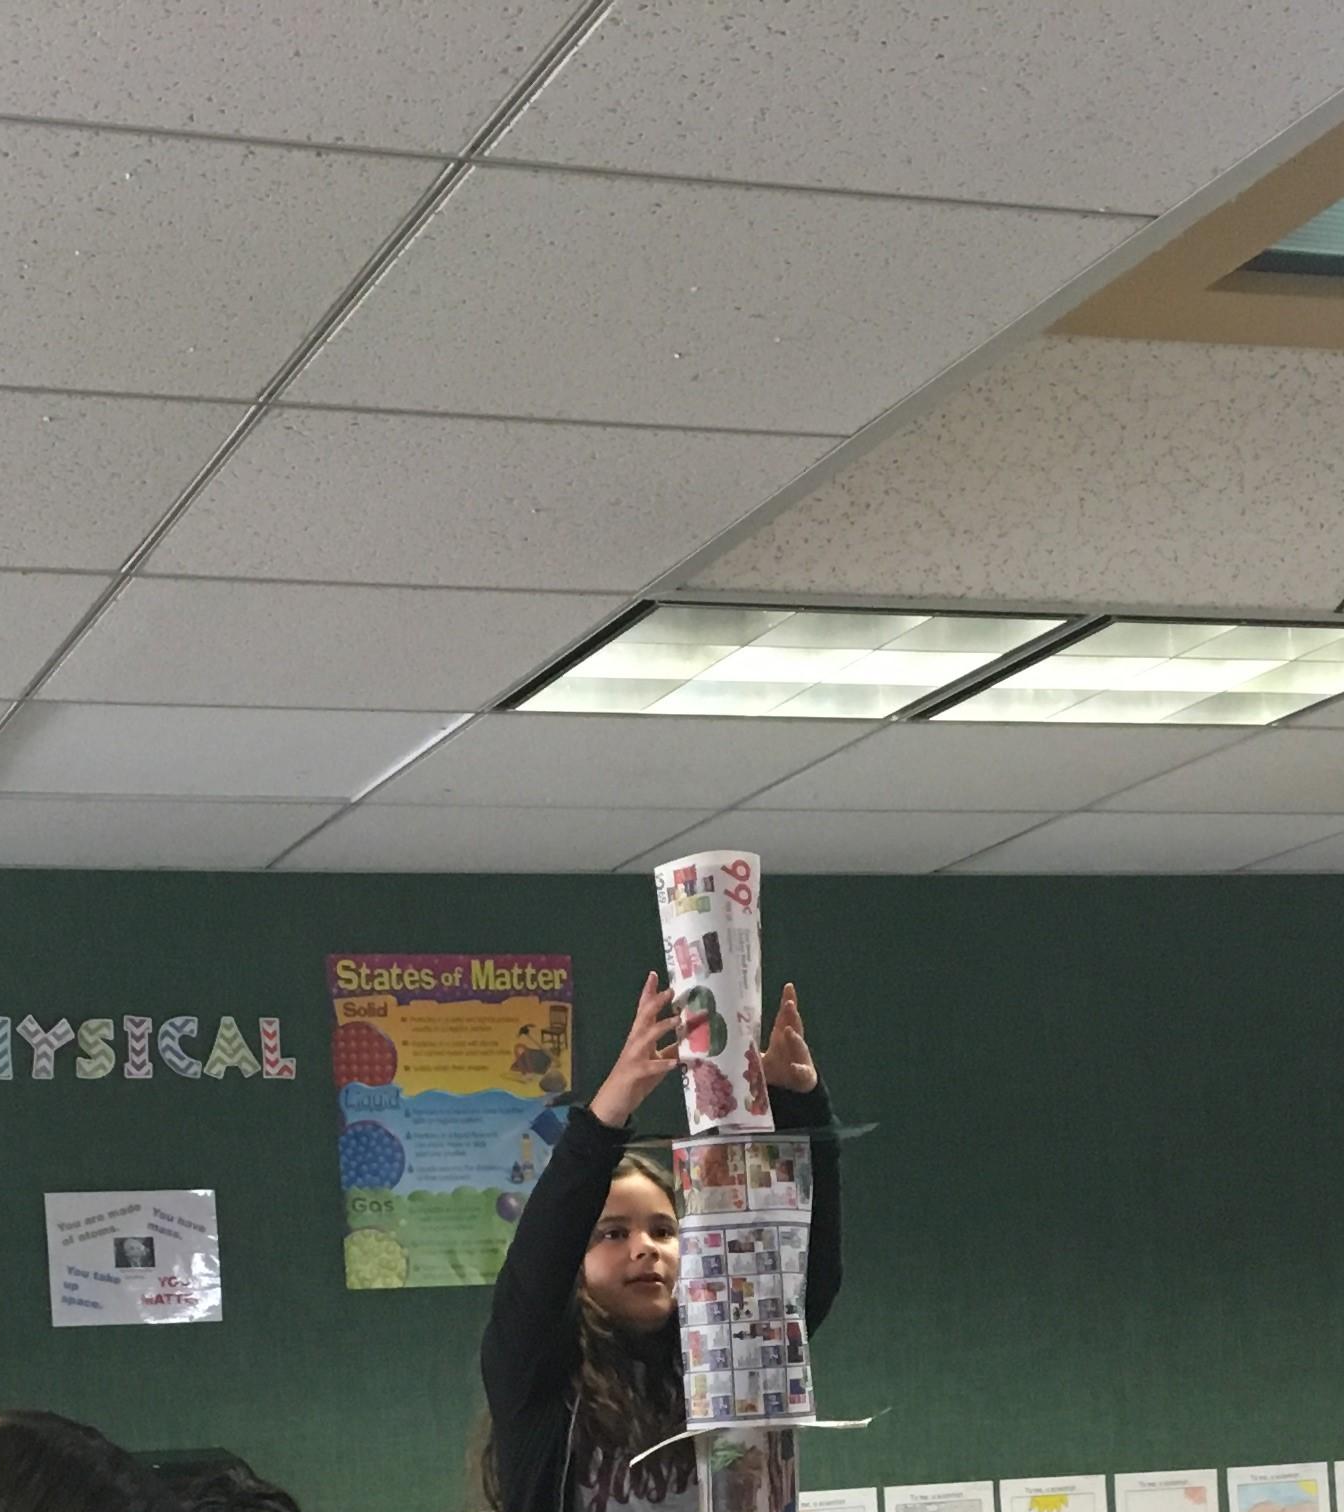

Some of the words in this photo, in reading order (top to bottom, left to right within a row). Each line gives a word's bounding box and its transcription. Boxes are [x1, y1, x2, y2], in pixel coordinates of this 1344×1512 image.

[336, 959, 438, 991] States
[441, 967, 462, 988] of
[471, 959, 568, 991] Matter
[343, 1001, 388, 1018] Solid
[344, 1086, 400, 1112] Liquid
[351, 1197, 394, 1214] Gas
[57, 1220, 81, 1232] You
[84, 1213, 105, 1226] are
[107, 1203, 142, 1219] made
[153, 1207, 175, 1223] You
[177, 1216, 207, 1233] have
[63, 1281, 80, 1292] up
[67, 1265, 90, 1279] You
[93, 1271, 122, 1285] take
